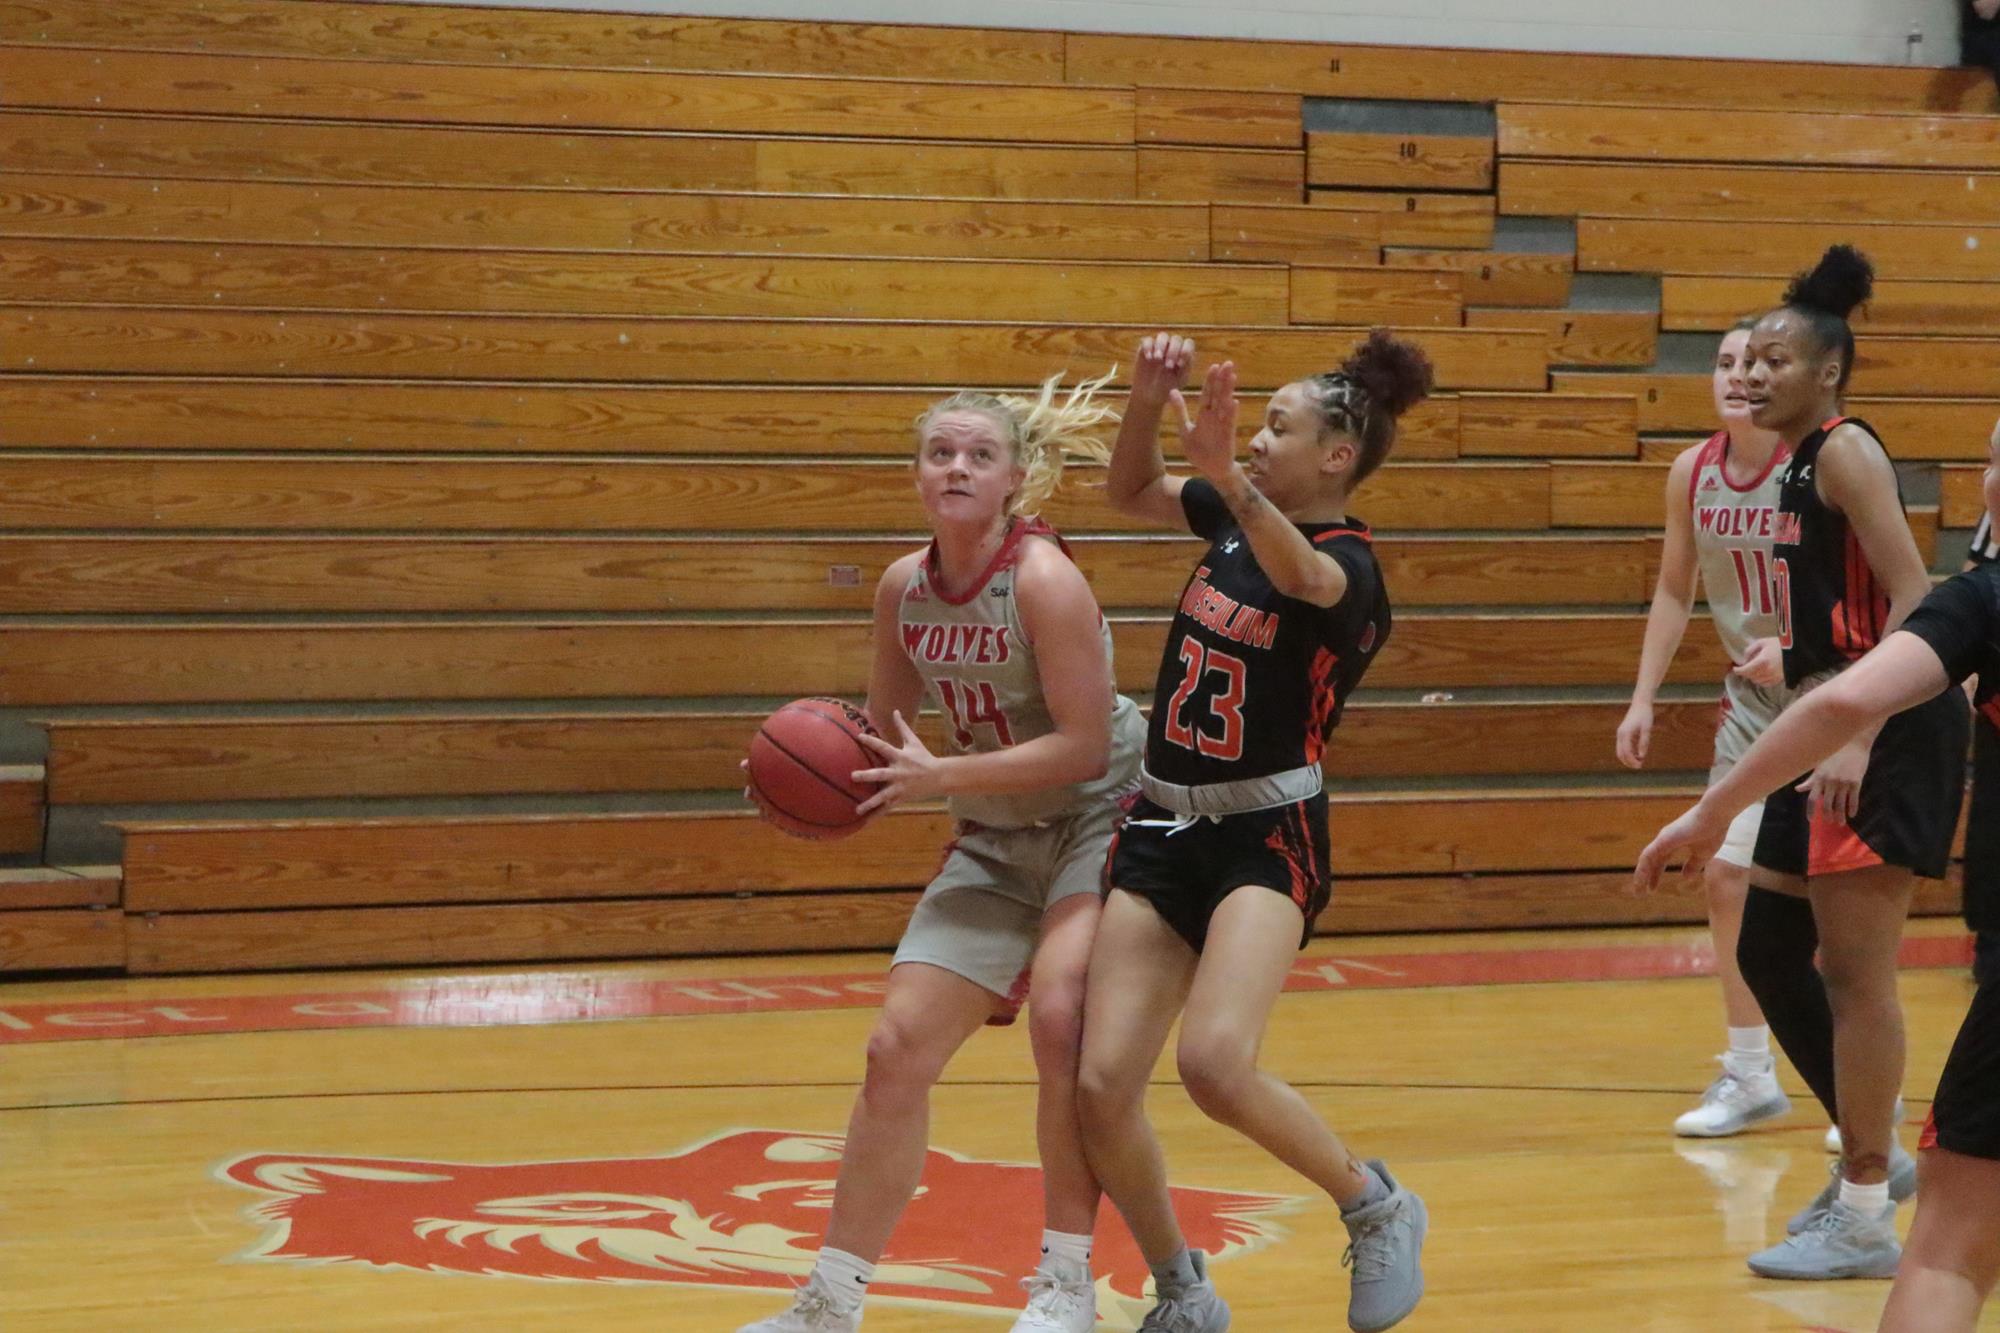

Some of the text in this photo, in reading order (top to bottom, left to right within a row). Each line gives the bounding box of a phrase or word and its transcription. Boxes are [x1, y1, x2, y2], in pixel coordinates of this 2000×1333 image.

[1400, 142, 1416, 158] 10
[1406, 197, 1416, 212] 9
[1563, 322, 1573, 337] 7
[1700, 507, 1774, 537] WOLVE
[1727, 549, 1774, 616] 11
[1180, 565, 1279, 650] TUSCULUM
[902, 622, 1010, 666] WOLVES
[936, 679, 1015, 749] 14
[1165, 634, 1247, 761] 23
